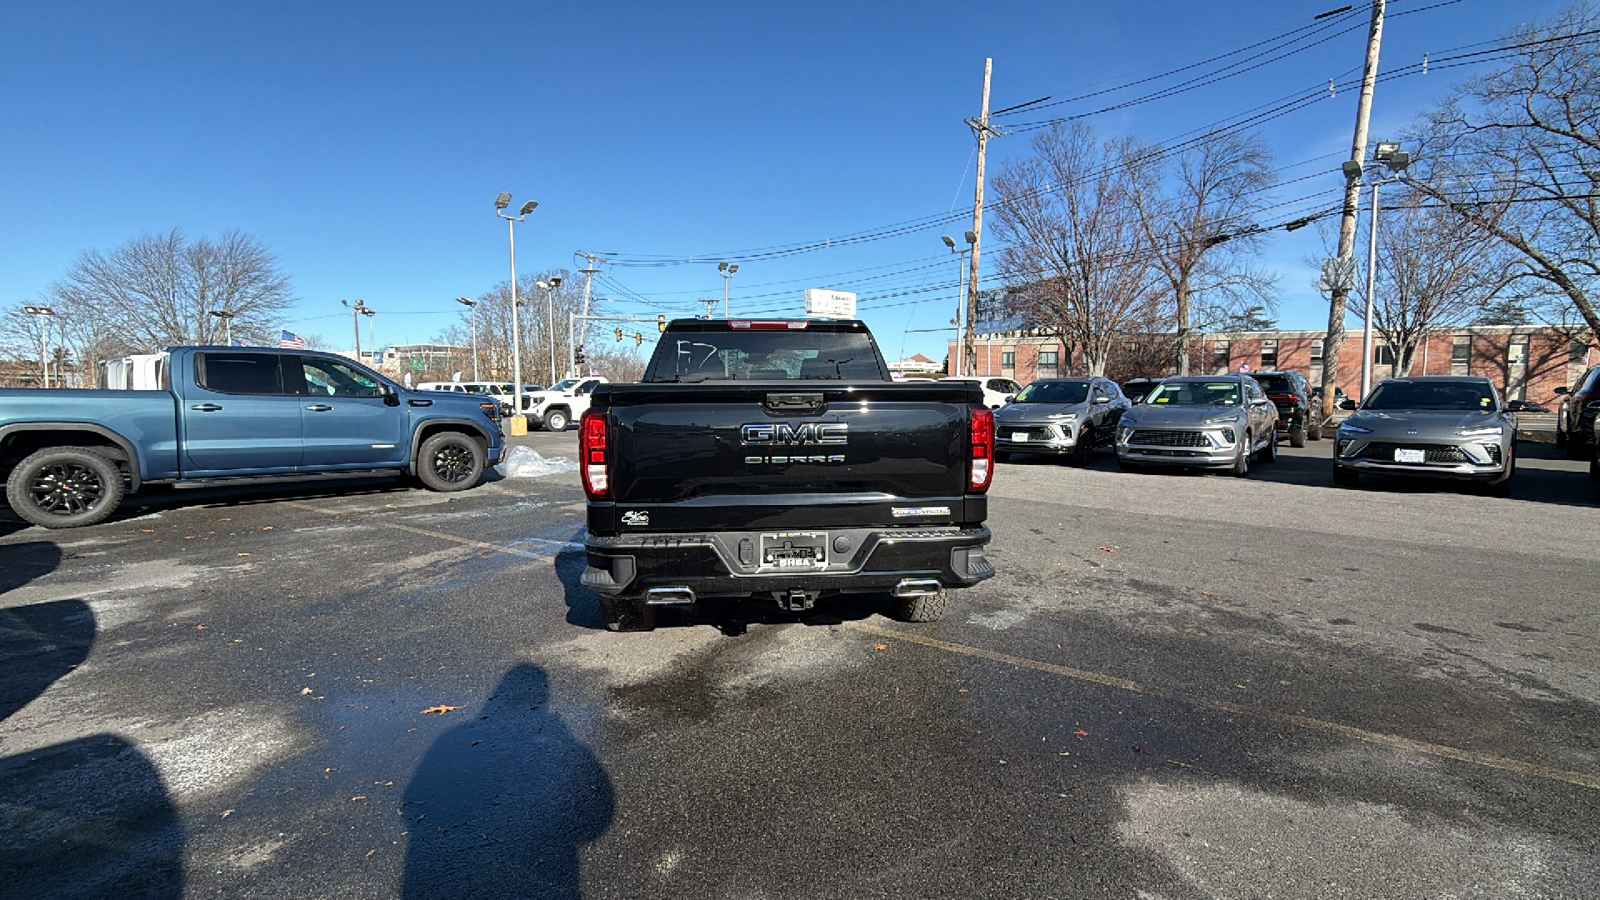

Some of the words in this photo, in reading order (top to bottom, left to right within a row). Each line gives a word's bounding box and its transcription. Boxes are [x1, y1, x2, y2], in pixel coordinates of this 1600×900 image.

[740, 423, 848, 445] GMC
[744, 454, 846, 464] SIERRA
[891, 507, 950, 517] VATION
